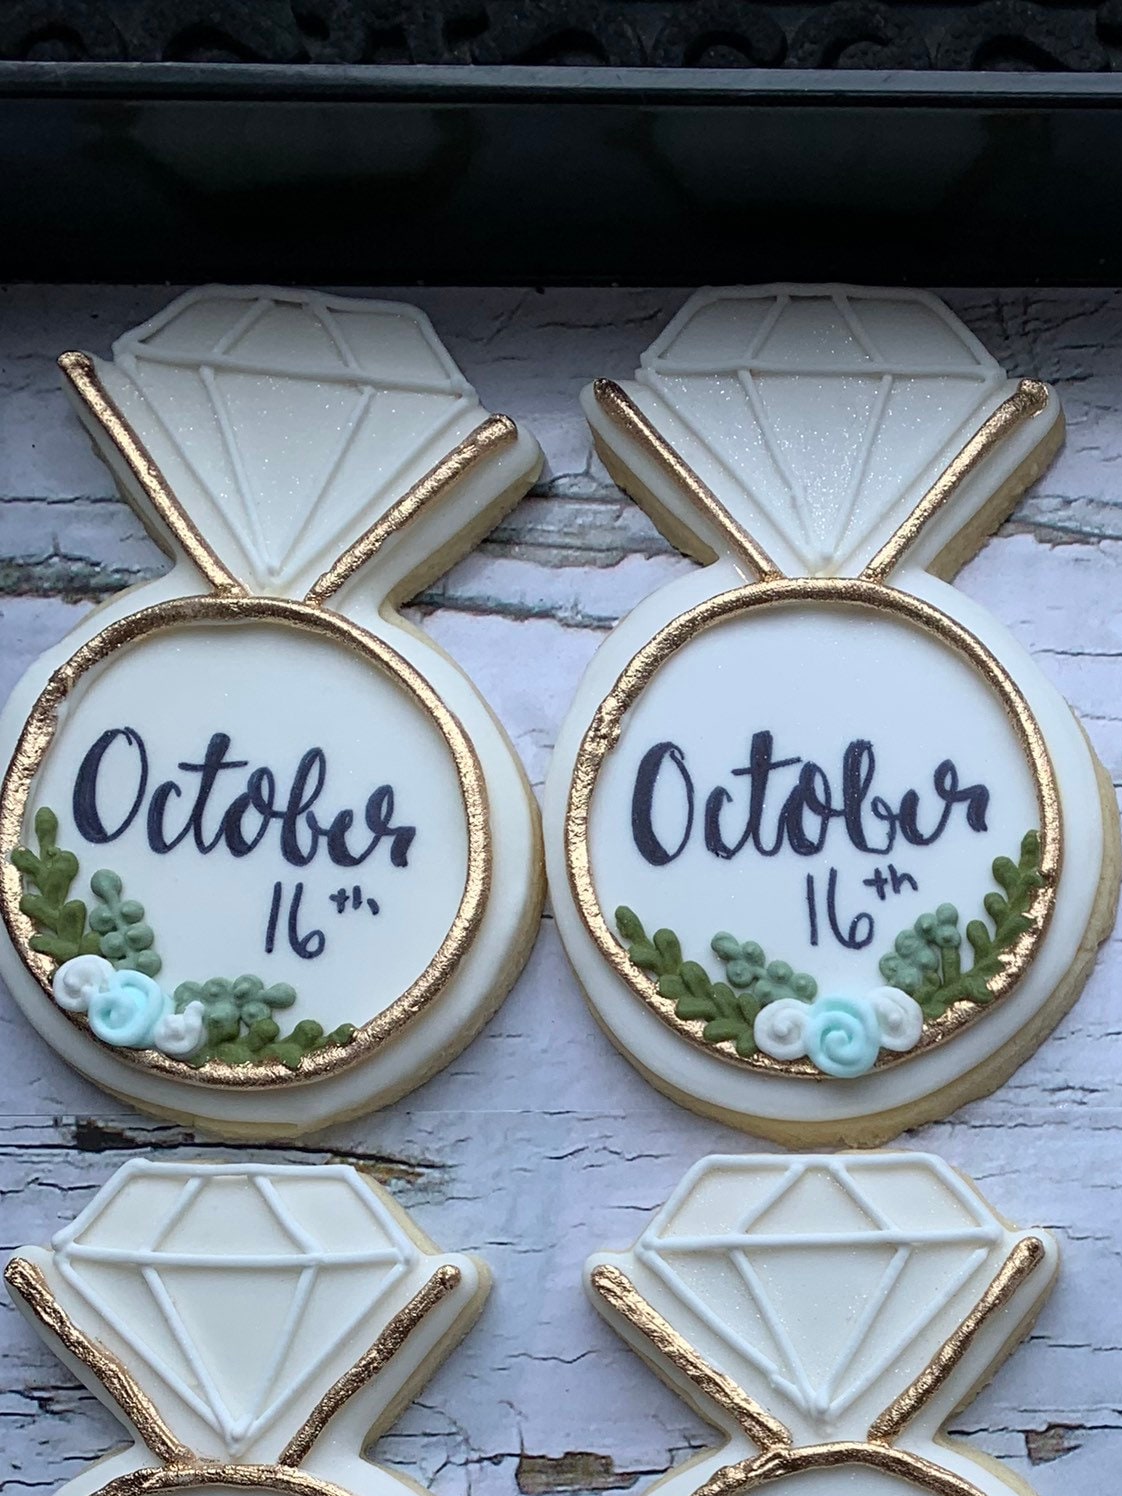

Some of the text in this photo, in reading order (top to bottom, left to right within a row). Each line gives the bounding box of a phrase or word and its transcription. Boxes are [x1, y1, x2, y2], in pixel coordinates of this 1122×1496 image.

[72, 726, 416, 868] October
[631, 730, 990, 866] October
[265, 881, 380, 960] 16th
[806, 863, 918, 951] 16th
